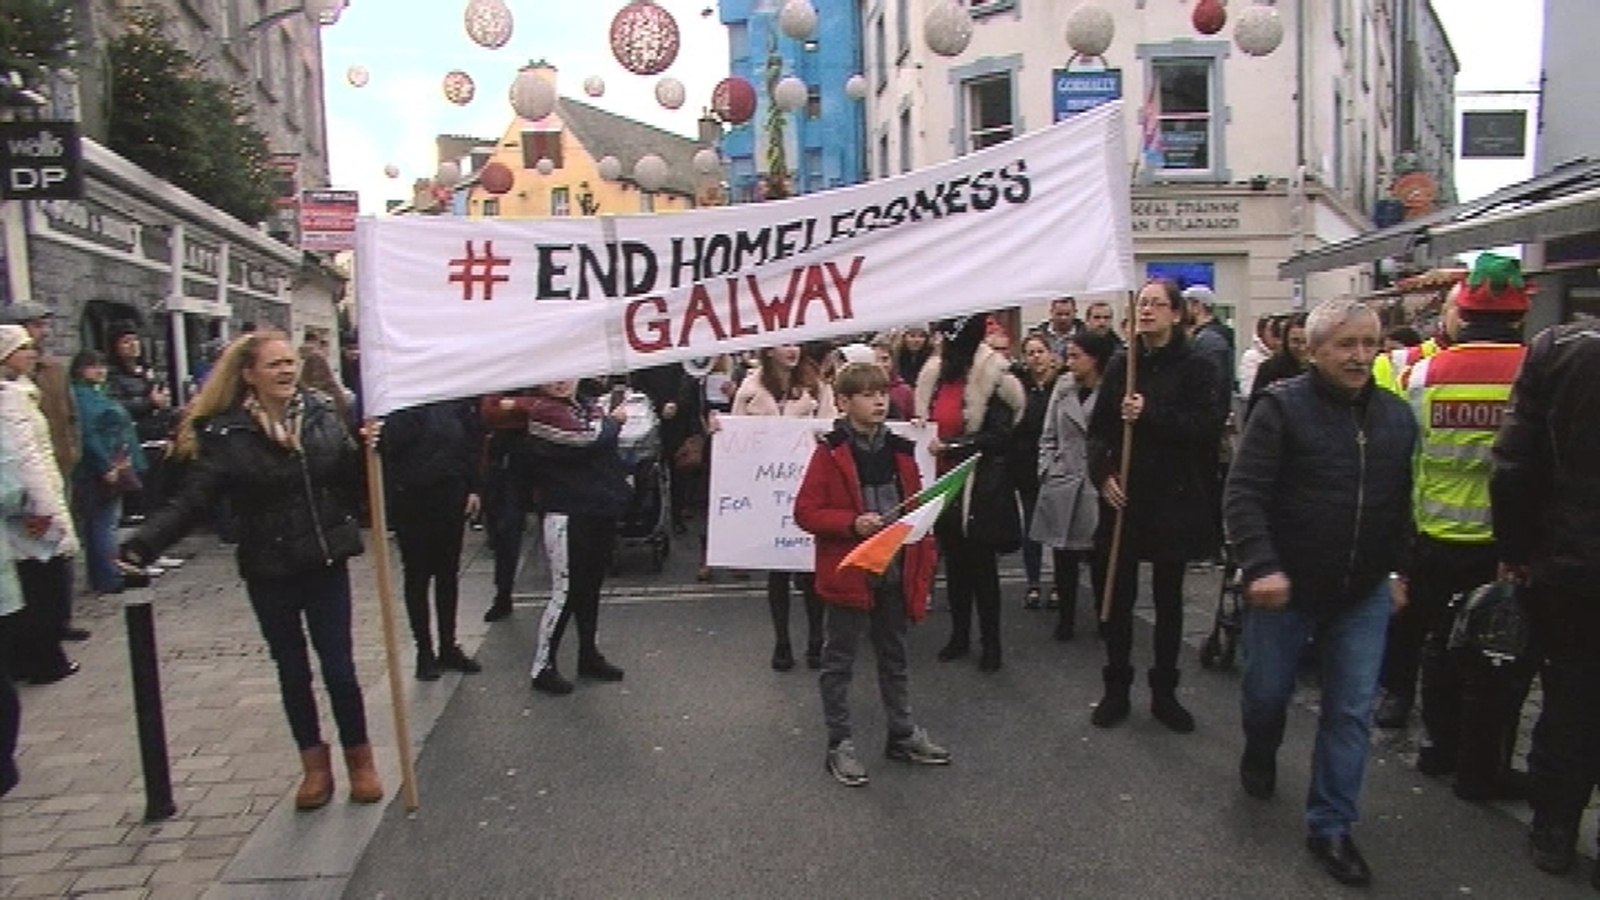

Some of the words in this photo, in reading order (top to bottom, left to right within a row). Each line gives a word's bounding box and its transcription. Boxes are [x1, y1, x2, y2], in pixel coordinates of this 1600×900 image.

[10, 167, 68, 190] DP
[535, 243, 659, 300] END
[671, 160, 1032, 288] HOMELESSNESS
[625, 256, 866, 354] GALWAY
[755, 462, 805, 482] MAR
